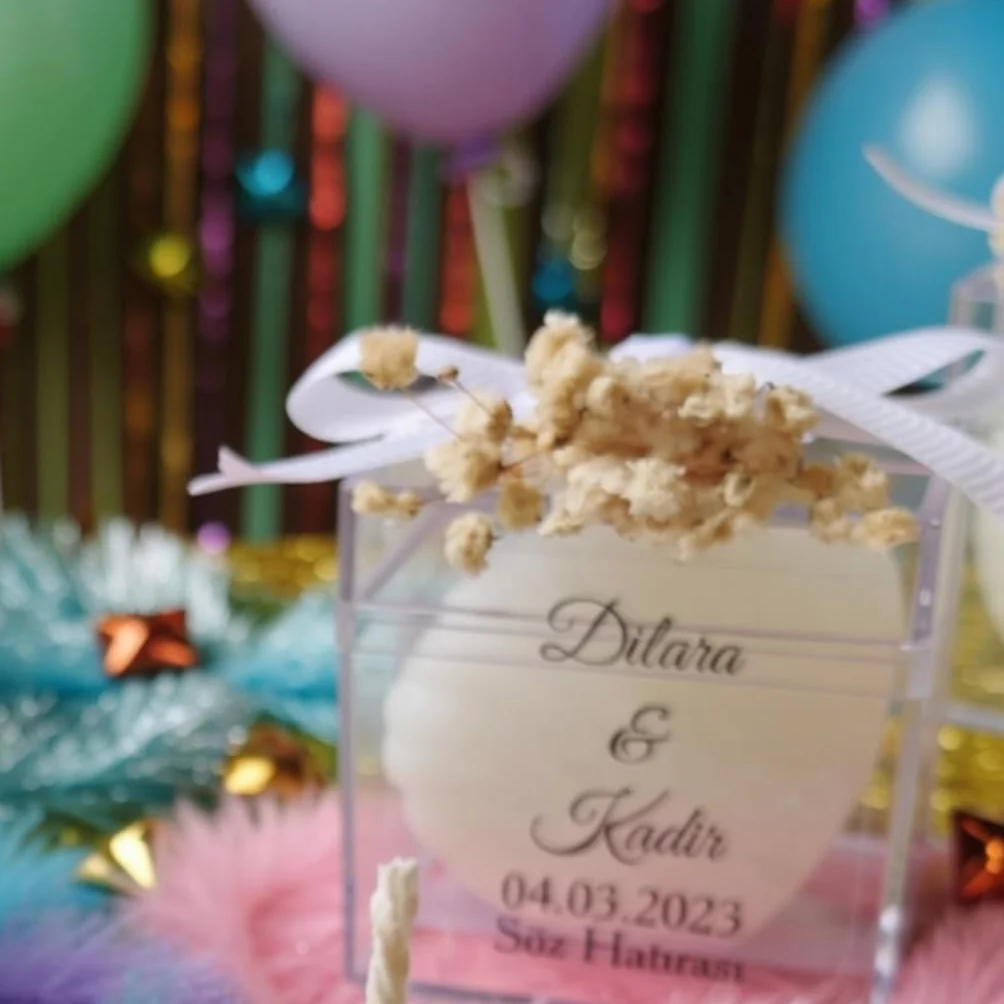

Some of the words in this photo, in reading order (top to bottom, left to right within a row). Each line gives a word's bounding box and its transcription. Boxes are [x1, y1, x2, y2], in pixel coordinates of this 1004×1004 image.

[609, 704, 672, 764] &
[530, 786, 729, 866] Kadir
[501, 871, 744, 938] 04.03.2023
